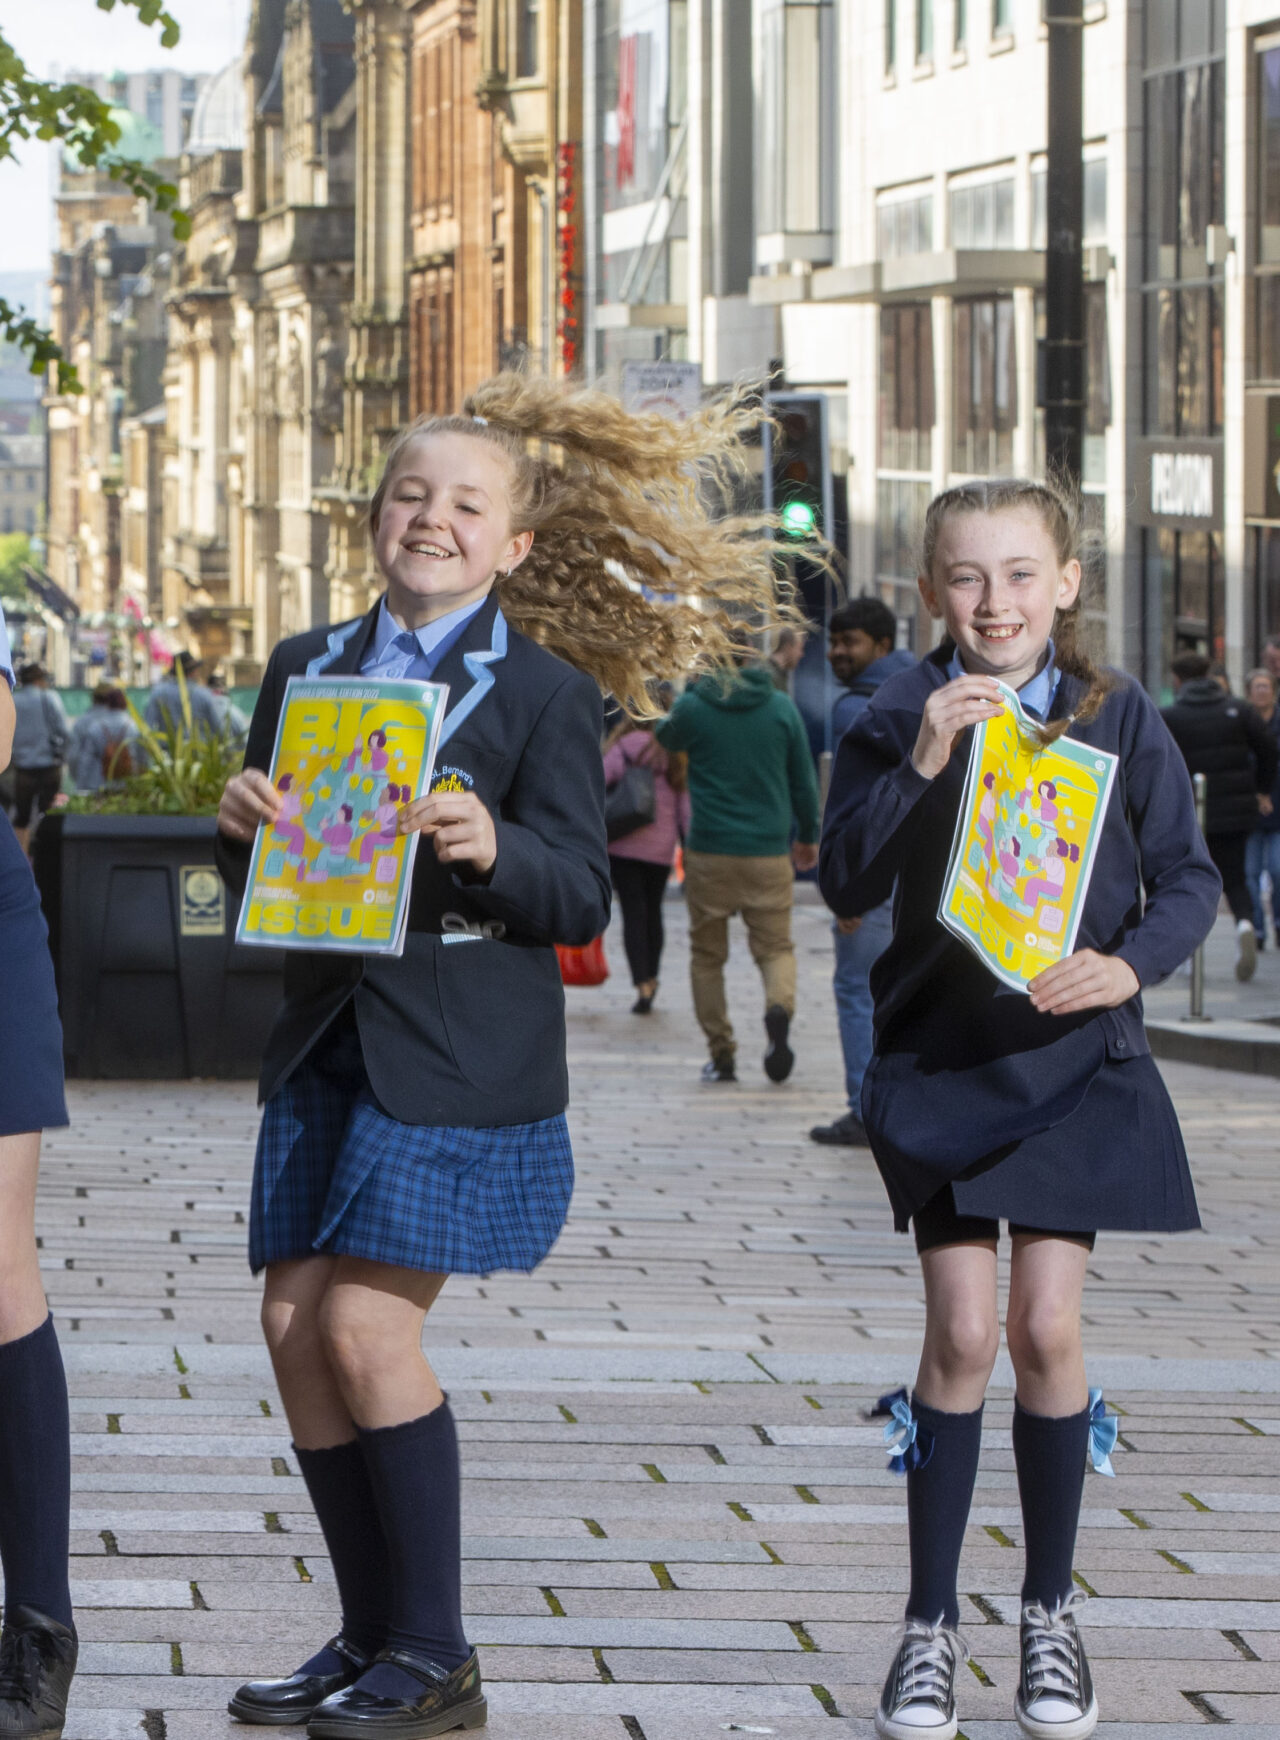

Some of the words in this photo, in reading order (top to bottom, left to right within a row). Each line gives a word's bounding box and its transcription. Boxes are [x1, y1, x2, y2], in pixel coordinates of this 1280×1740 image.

[278, 699, 427, 758] BIG
[442, 765, 474, 786] Bernard's
[244, 903, 395, 940] ISSUE
